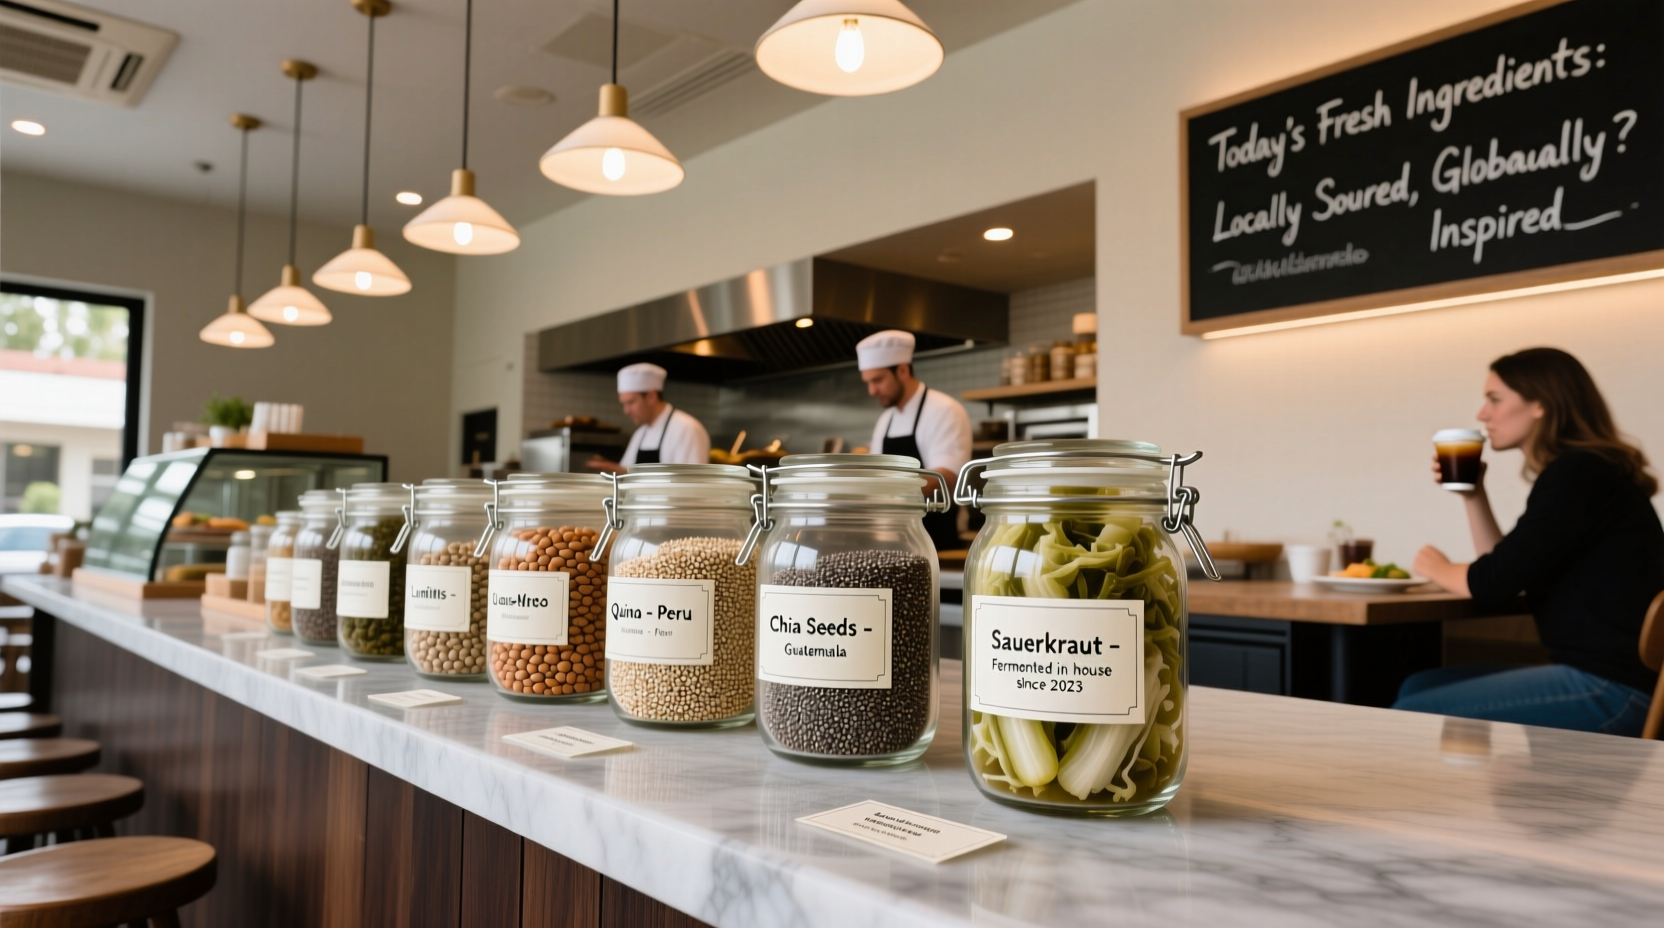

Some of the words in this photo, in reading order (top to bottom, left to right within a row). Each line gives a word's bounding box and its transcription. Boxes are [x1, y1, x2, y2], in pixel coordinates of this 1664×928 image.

[1208, 116, 1306, 177] Today's
[1316, 90, 1392, 145] Fresh
[1406, 37, 1607, 132] Ingredients:
[1212, 190, 1302, 245] Locally
[1312, 161, 1419, 221] Soured,
[1430, 186, 1565, 264] Inspired
[658, 605, 692, 621] Peru
[770, 615, 801, 633] Chia
[807, 617, 857, 636] Seeds
[992, 629, 1102, 655] Sauerkraut
[1057, 662, 1068, 675] in
[1074, 663, 1112, 676] house
[1051, 680, 1083, 693] 2023
